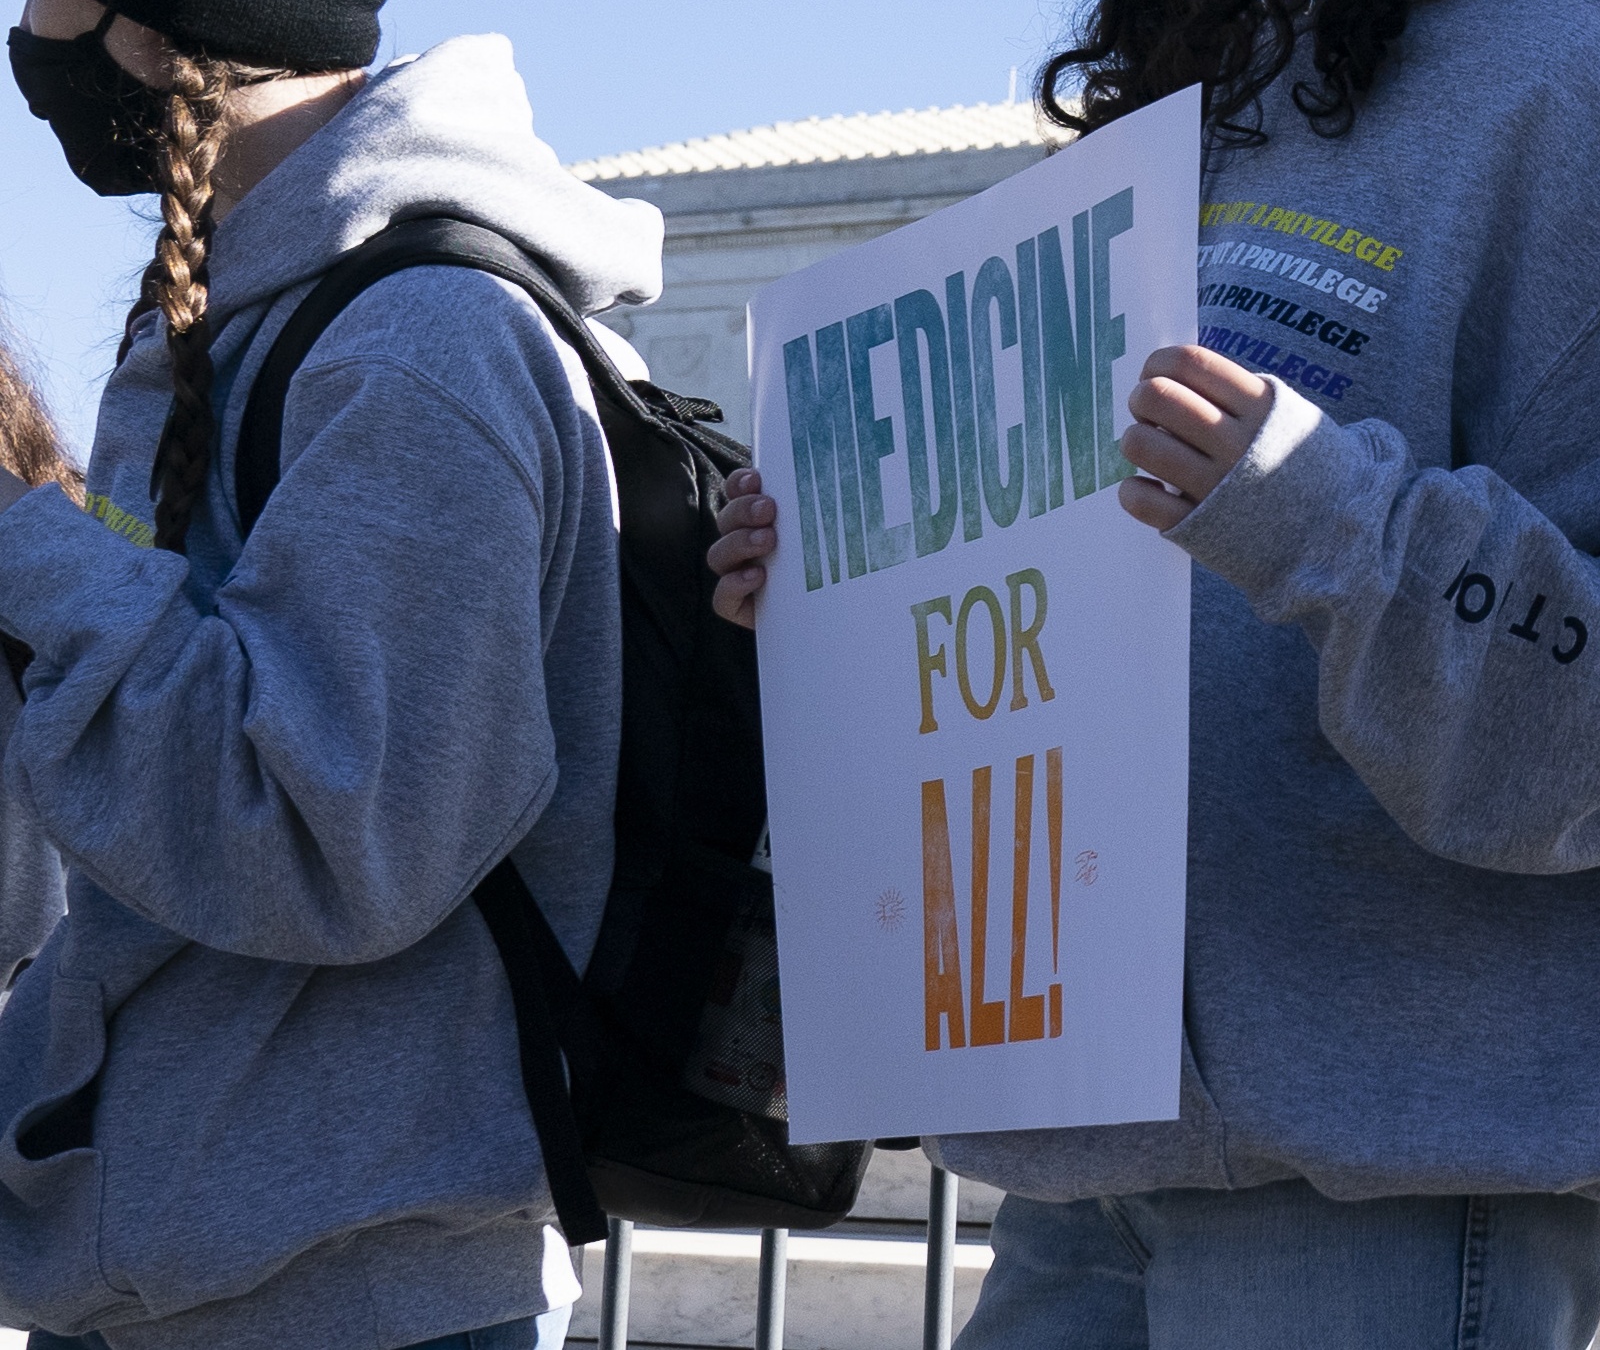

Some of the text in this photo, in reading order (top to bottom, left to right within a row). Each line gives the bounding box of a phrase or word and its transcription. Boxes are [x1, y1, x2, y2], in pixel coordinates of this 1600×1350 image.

[1262, 207, 1403, 272] PRIVILEGE
[1239, 245, 1388, 313] PRIVILEGE
[1220, 285, 1370, 356] PRIVILEGE
[783, 186, 1139, 593] MEDICINE
[1202, 326, 1353, 399] PRIVILEGE
[911, 566, 1055, 735] FOR
[921, 746, 1064, 1051] ALL!
